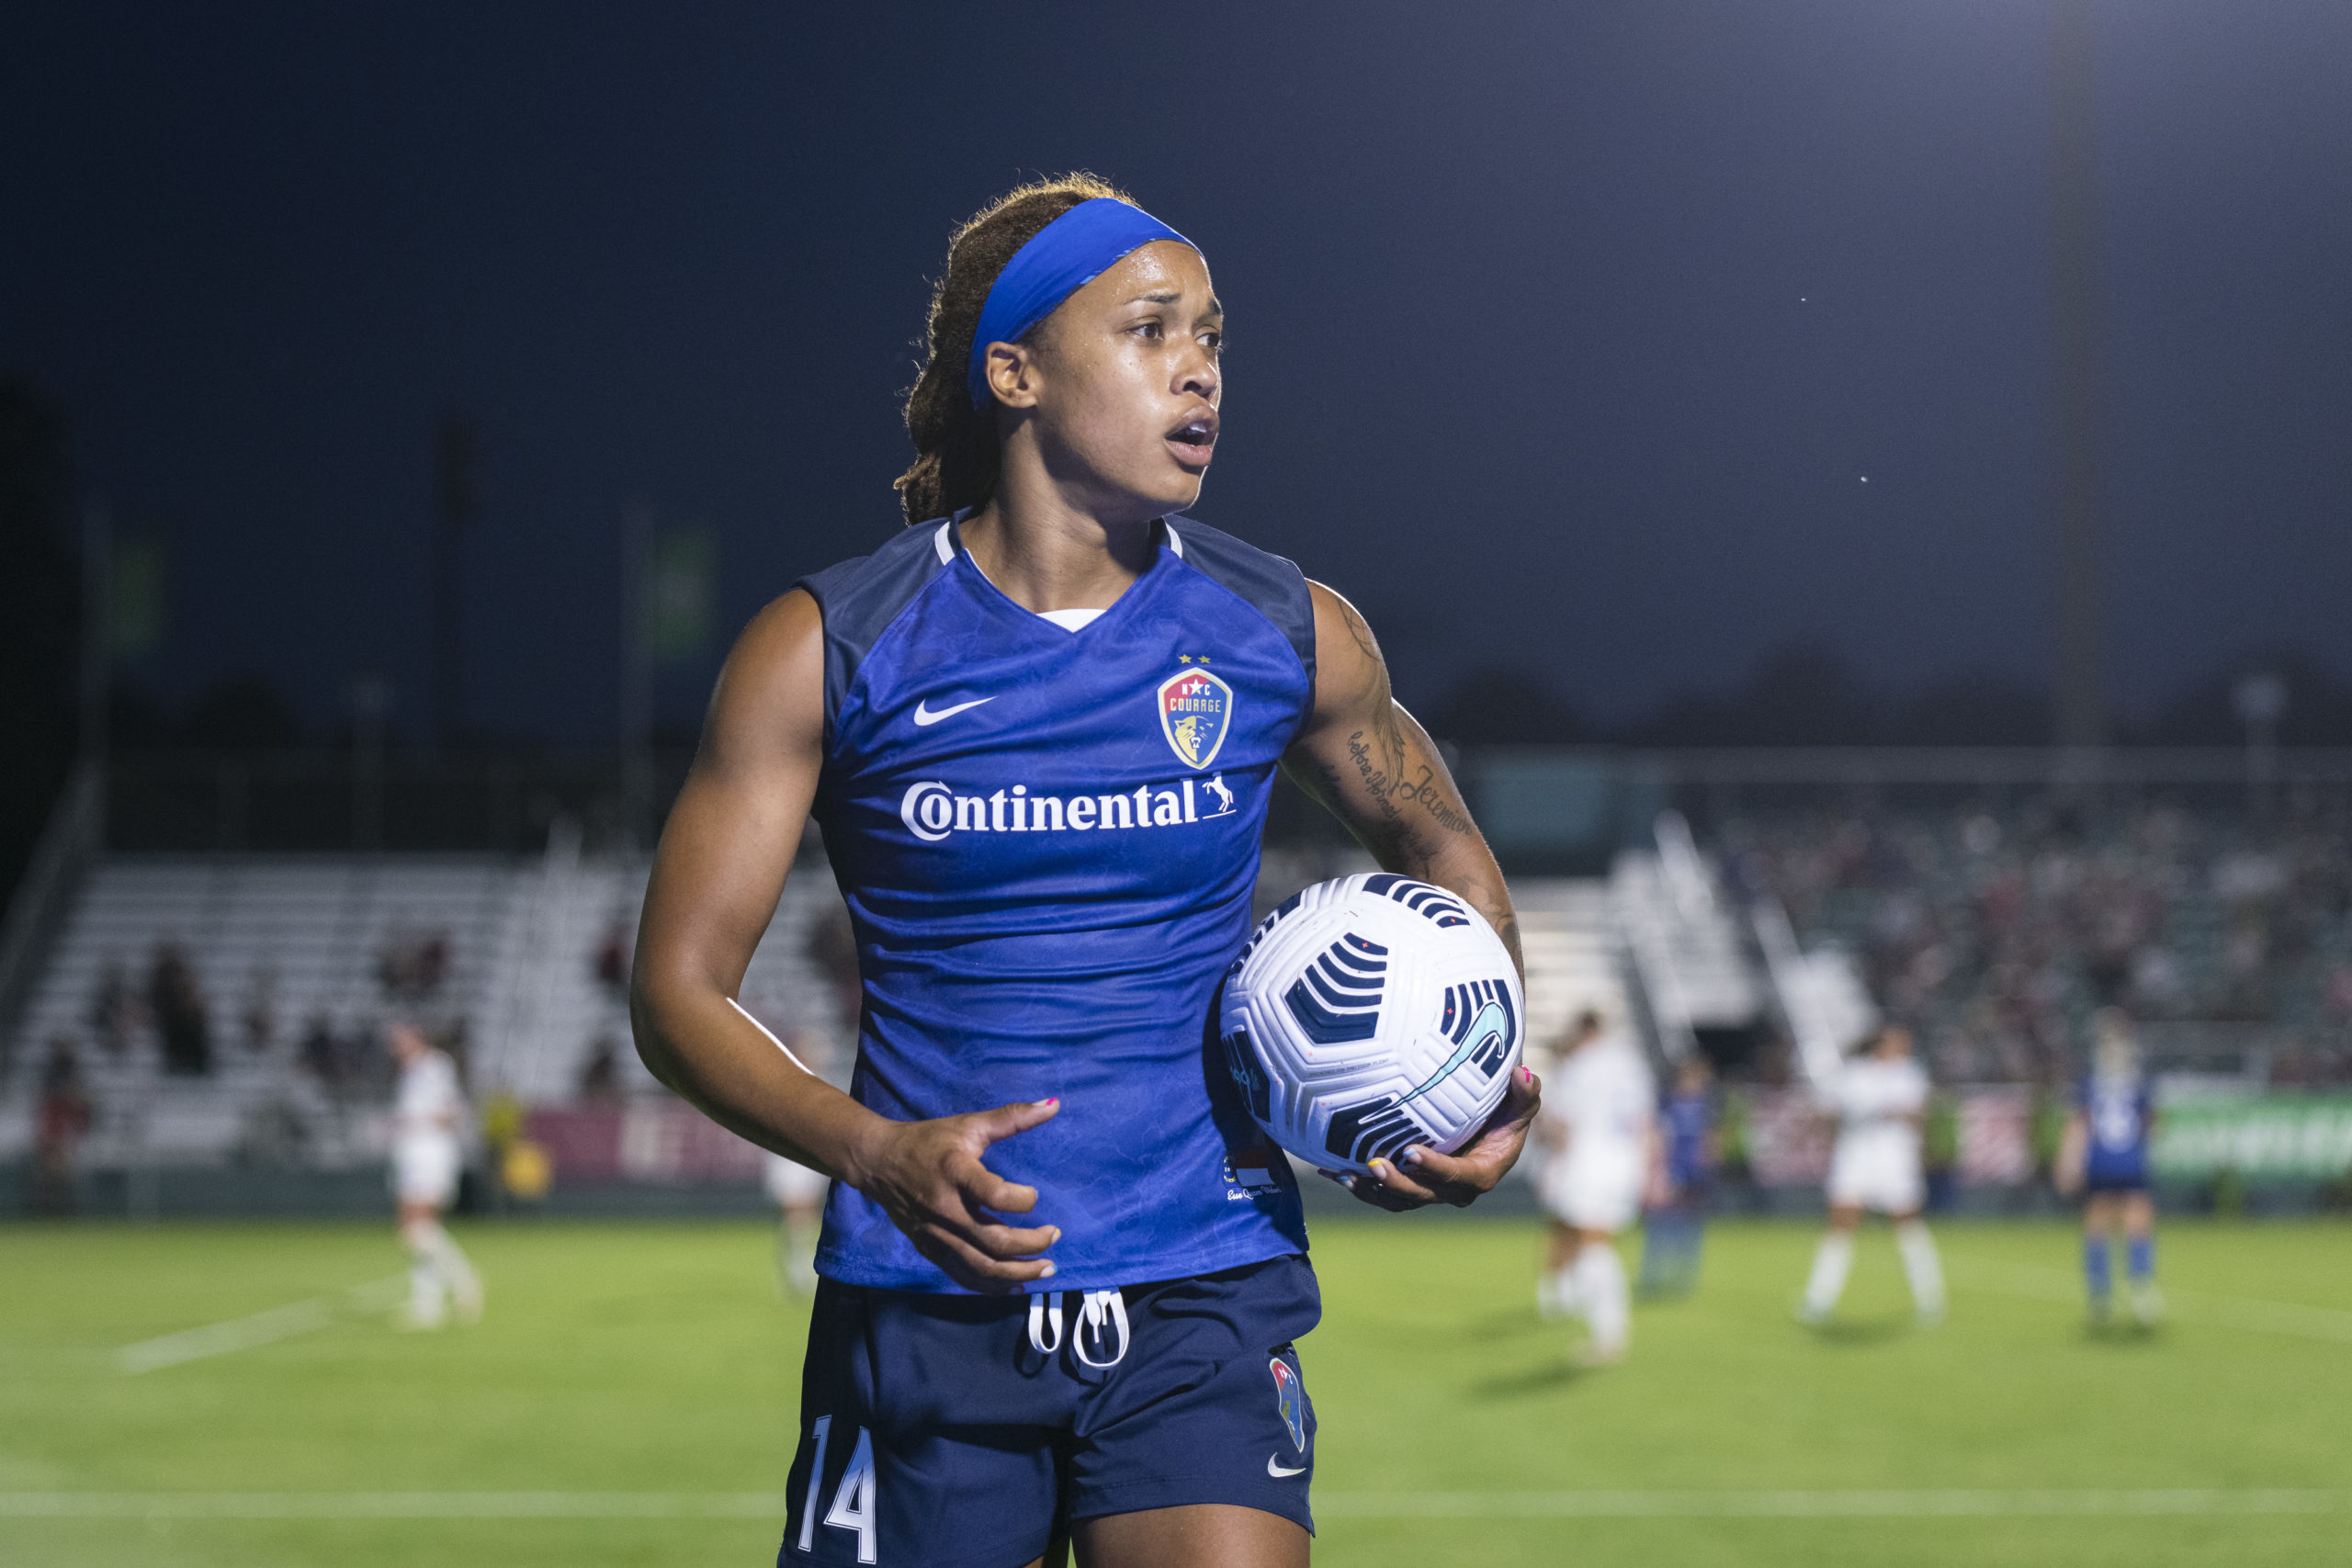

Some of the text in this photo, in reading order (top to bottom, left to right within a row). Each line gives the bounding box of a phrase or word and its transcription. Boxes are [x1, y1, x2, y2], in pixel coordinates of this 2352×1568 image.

[1170, 697, 1221, 713] COURAGE
[1348, 731, 1373, 776] before
[900, 777, 1198, 841] Continental
[797, 1414, 876, 1565] 14
